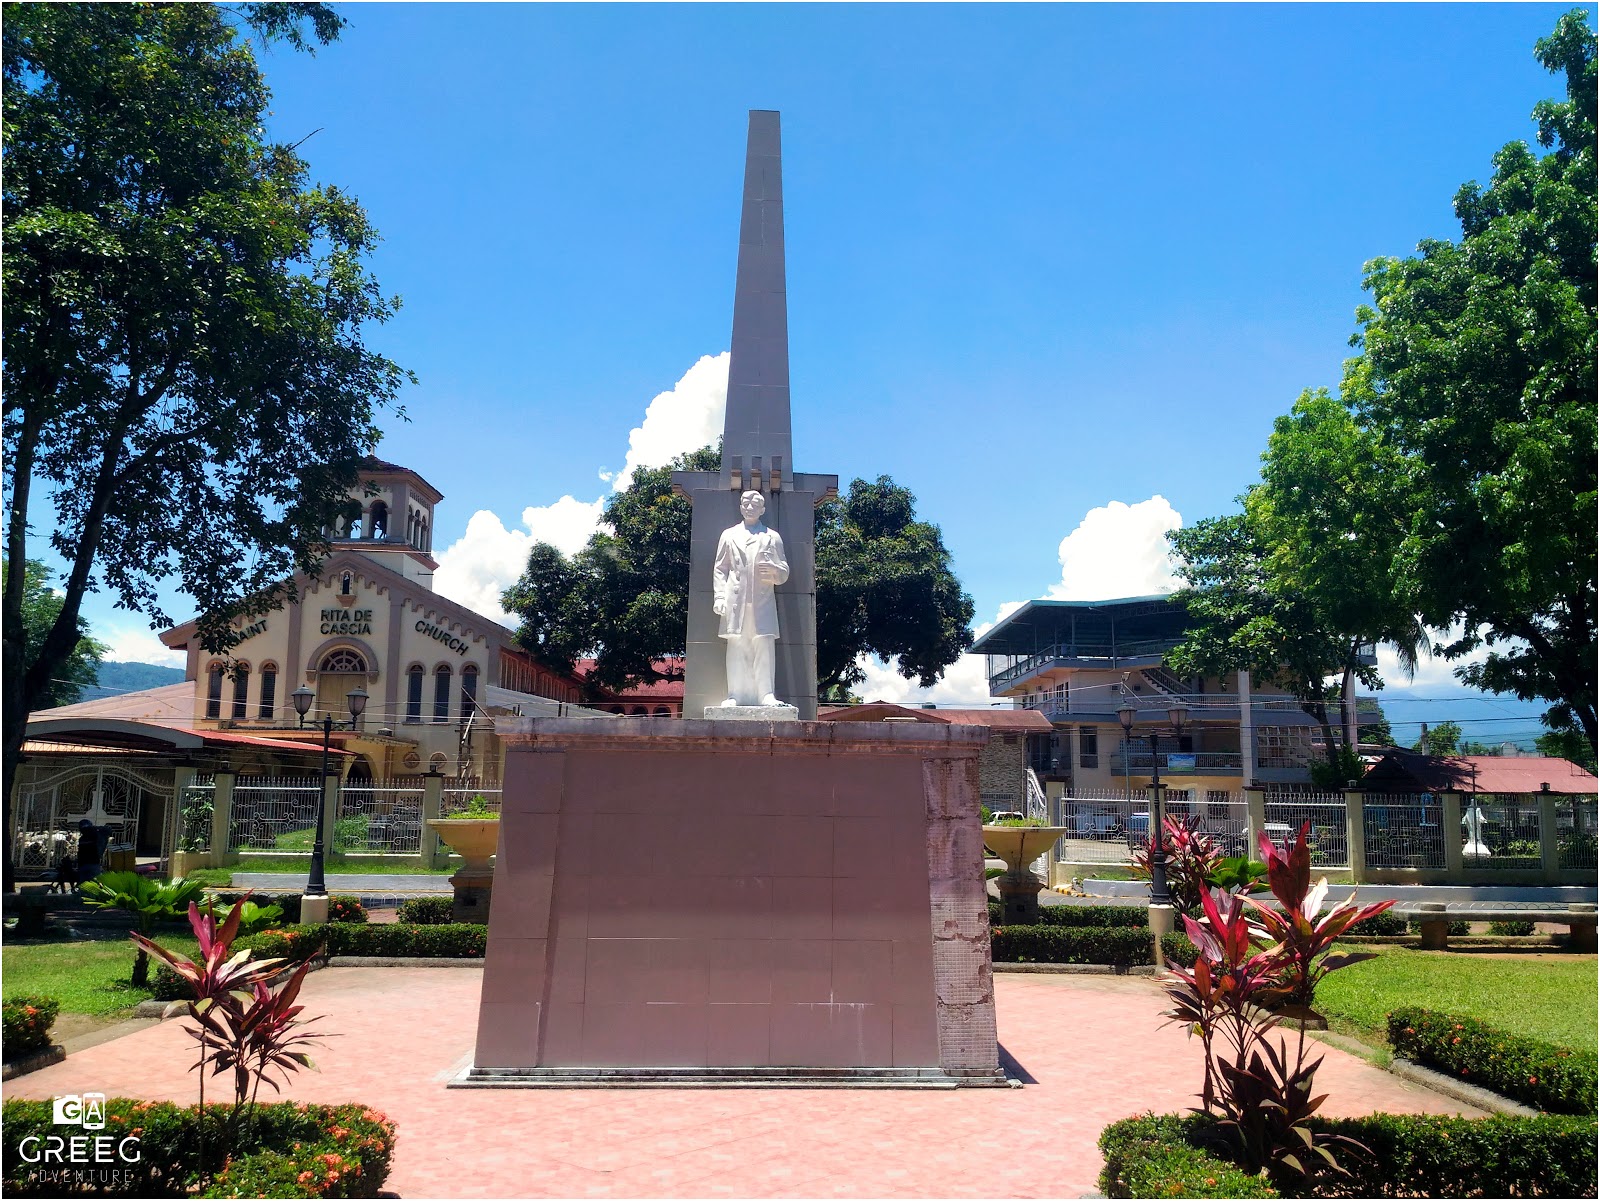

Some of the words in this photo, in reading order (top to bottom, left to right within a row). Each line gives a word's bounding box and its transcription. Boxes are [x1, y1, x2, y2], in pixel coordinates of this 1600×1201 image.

[320, 609, 350, 622] RITA
[353, 609, 373, 622] DE
[232, 619, 268, 645] AINT
[320, 622, 372, 635] CASCIA
[414, 620, 469, 656] CHURCH
